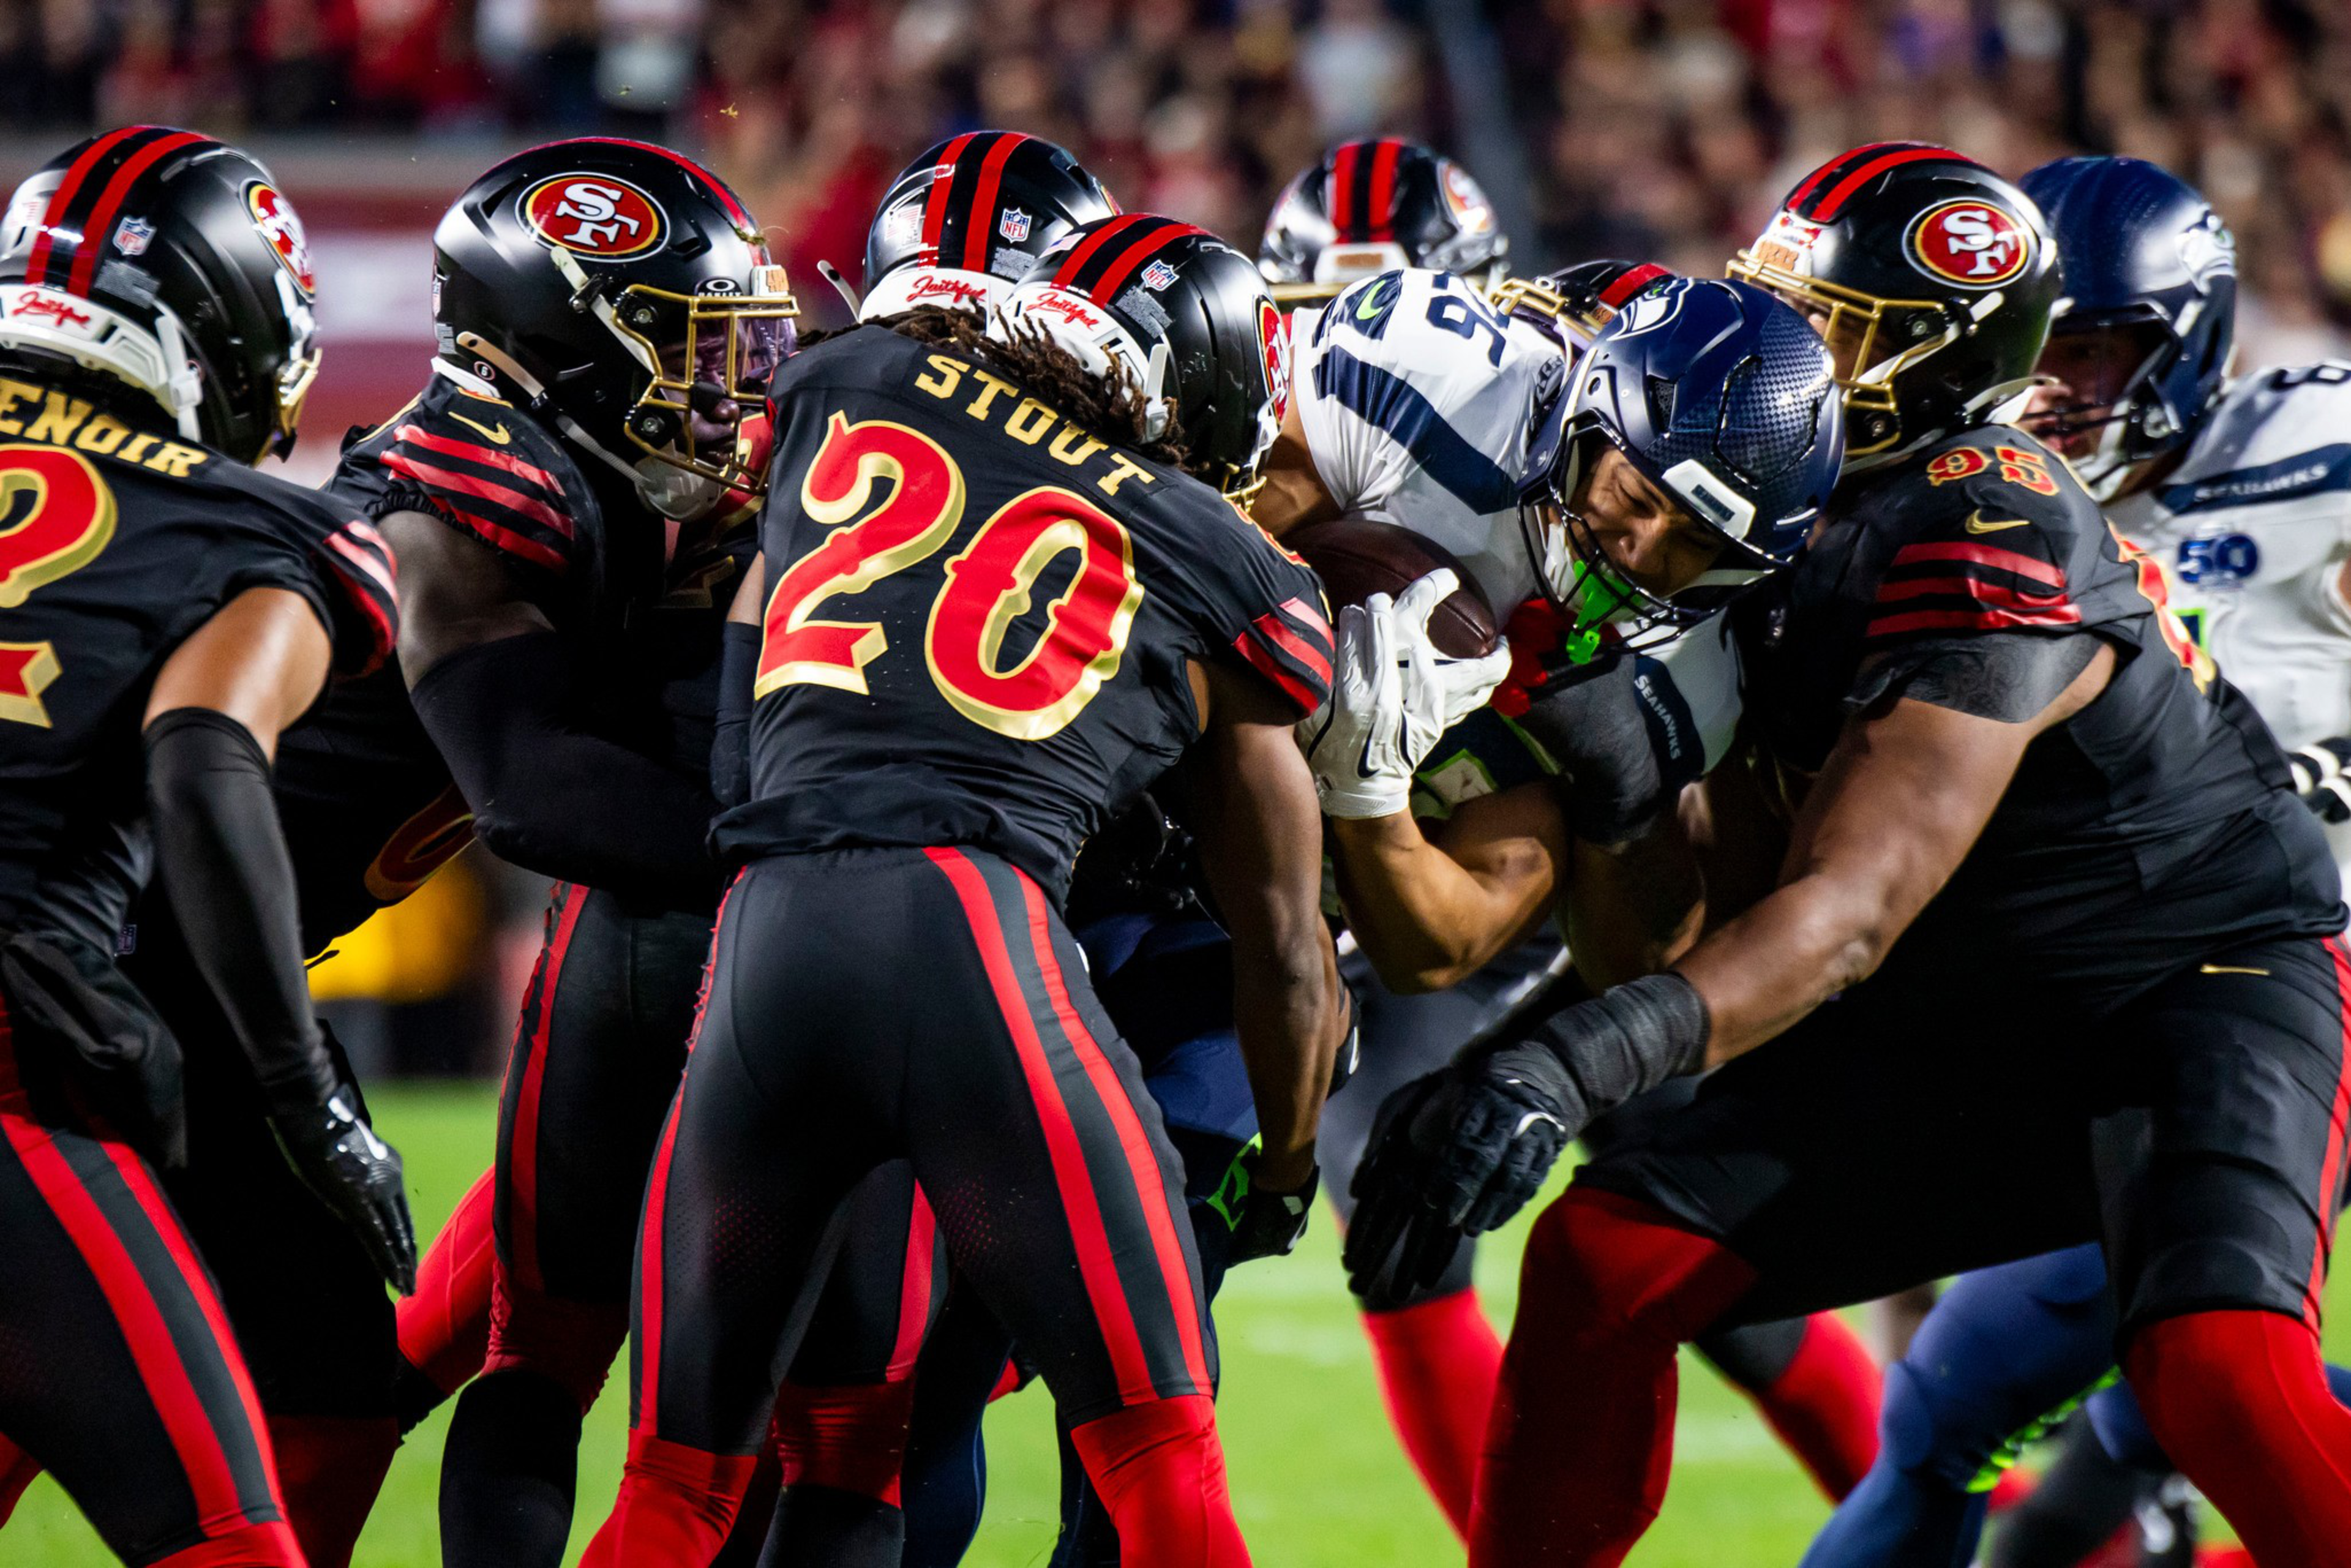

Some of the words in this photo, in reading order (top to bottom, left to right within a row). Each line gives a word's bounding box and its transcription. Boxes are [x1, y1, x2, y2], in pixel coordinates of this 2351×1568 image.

[556, 183, 640, 247] SF
[1003, 222, 1024, 238] NFL
[1943, 210, 2015, 275] SF
[1146, 268, 1166, 288] NFL
[915, 354, 1156, 497] STOUT
[754, 409, 1145, 741] 20
[1633, 675, 1682, 760] SEAHAWKS
